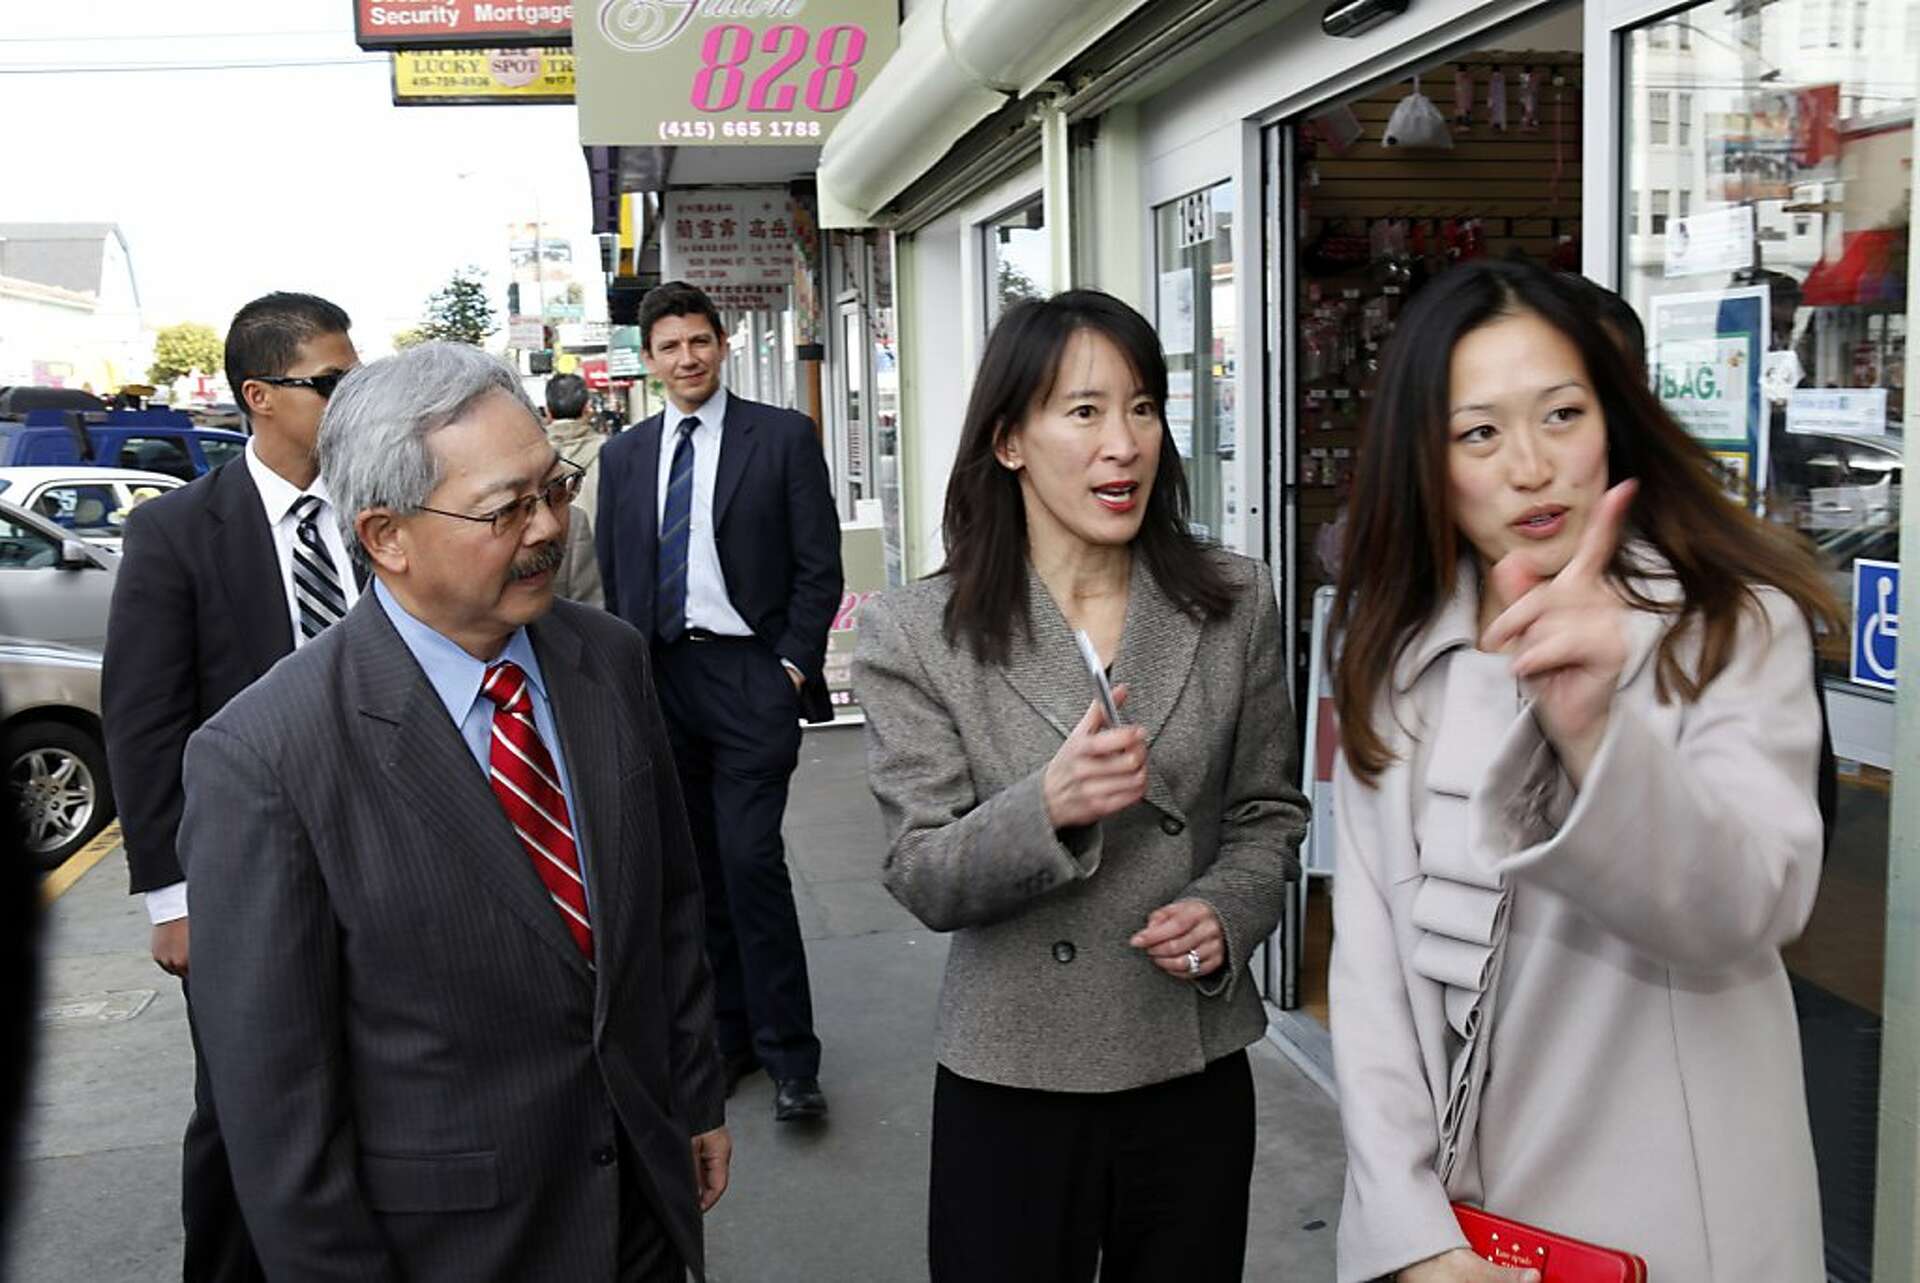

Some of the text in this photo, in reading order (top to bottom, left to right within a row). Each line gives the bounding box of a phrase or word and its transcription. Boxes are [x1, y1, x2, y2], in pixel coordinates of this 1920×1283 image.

[370, 4, 575, 26] Security Mortgage
[413, 59, 481, 73] LUCKY
[491, 59, 537, 73] SPOT
[690, 24, 868, 113] 828
[658, 121, 820, 139] (415) 665 1788
[1663, 366, 1723, 400] BAG.
